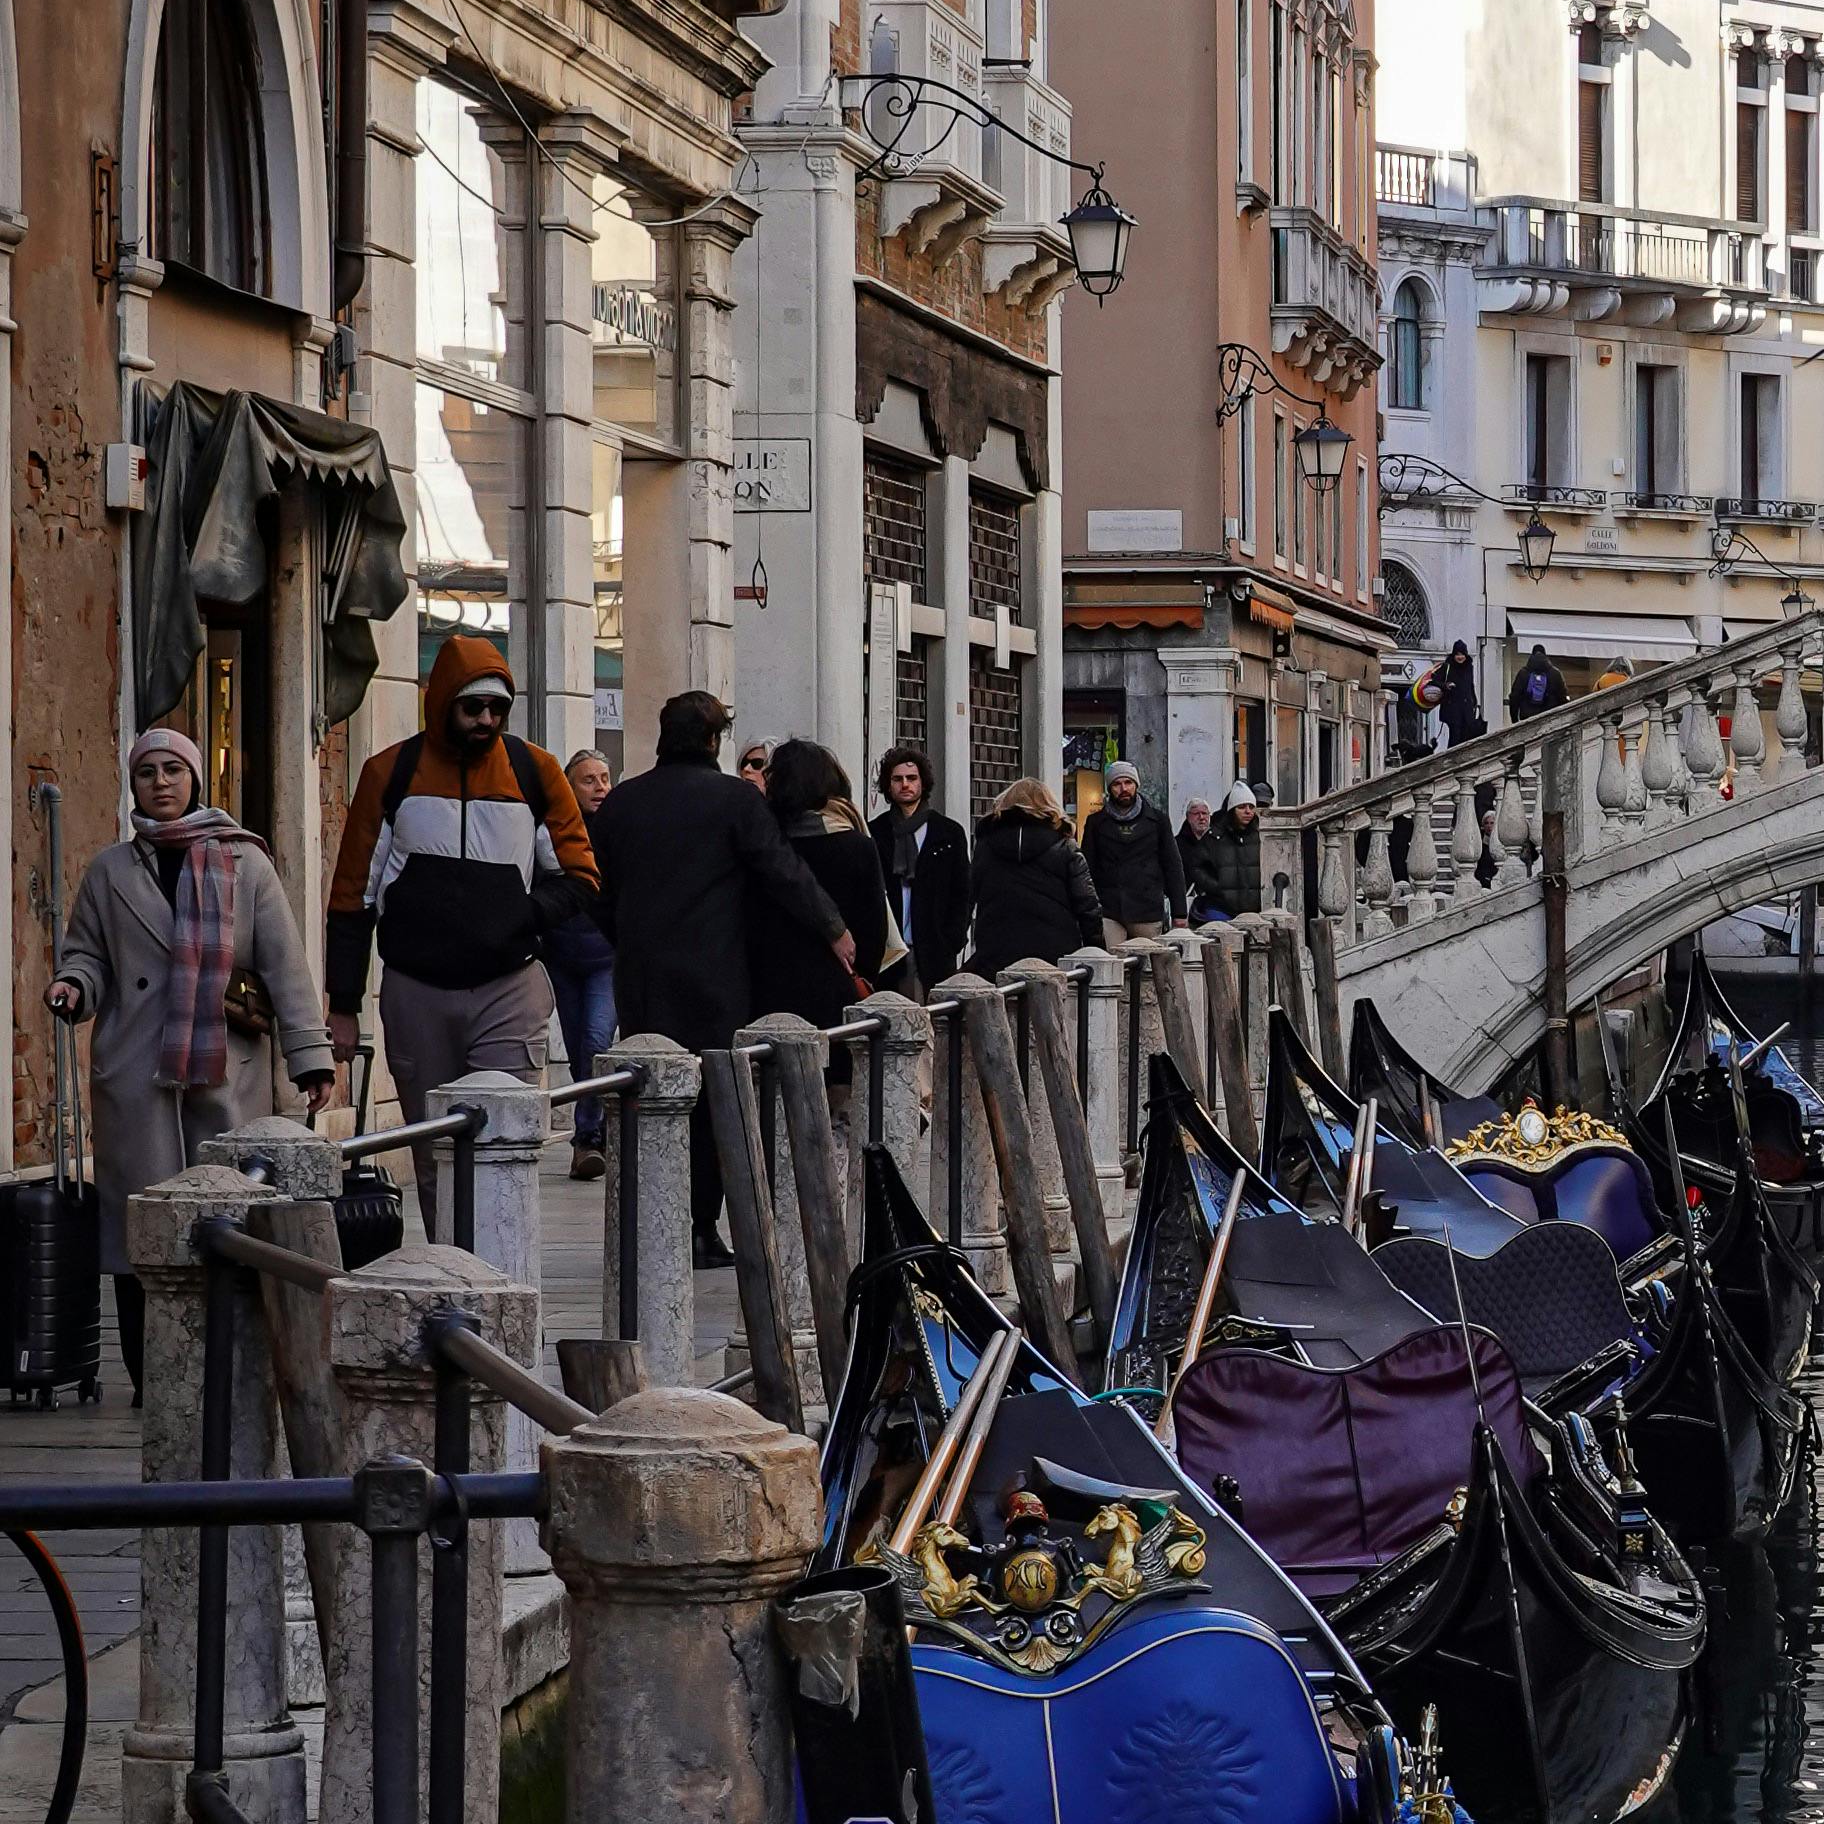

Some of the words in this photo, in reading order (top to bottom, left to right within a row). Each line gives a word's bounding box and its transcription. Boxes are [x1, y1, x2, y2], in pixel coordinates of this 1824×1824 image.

[732, 452, 777, 470] LLE
[1591, 529, 1612, 538] CALLE
[1586, 541, 1617, 551] GOLDONI
